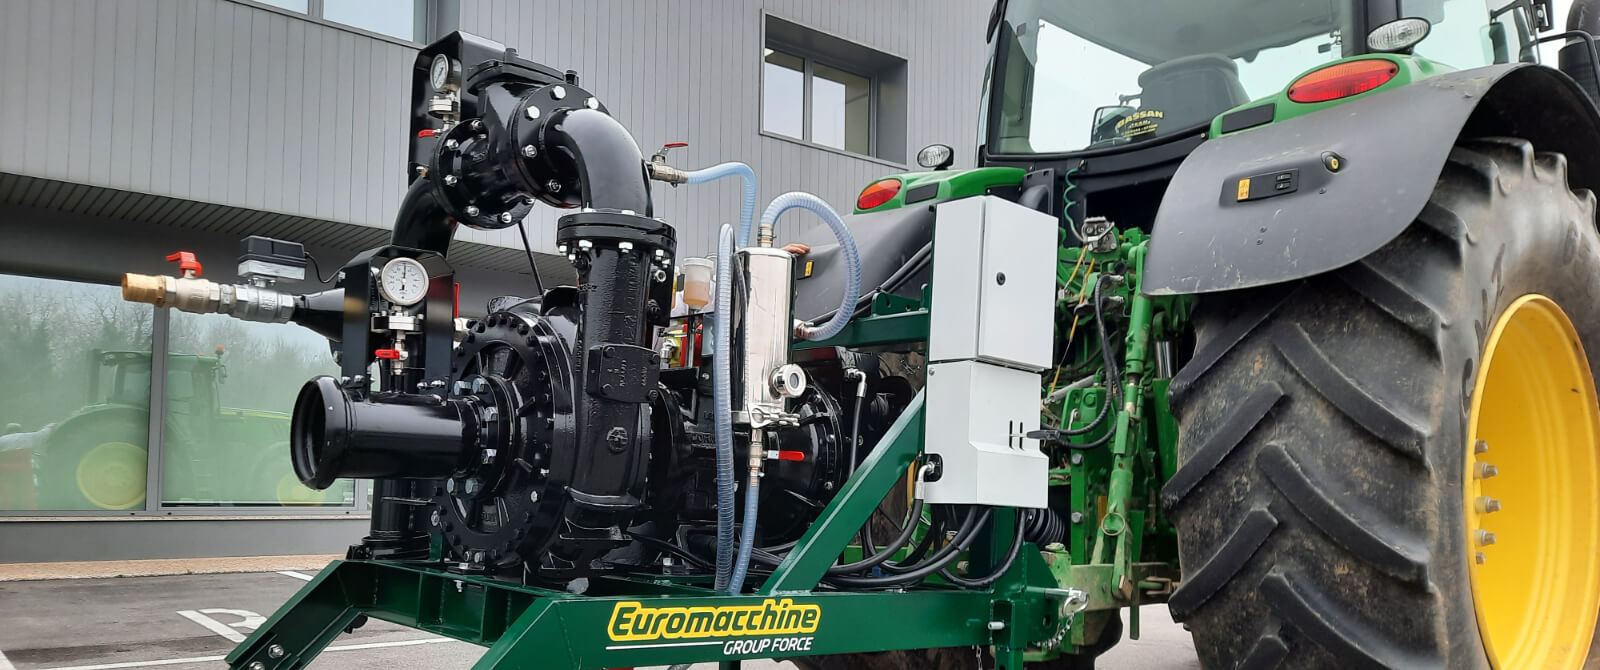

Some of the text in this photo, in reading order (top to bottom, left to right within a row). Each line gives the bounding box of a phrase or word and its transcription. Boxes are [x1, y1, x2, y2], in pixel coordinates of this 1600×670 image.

[610, 600, 820, 638] Euromacchine
[723, 637, 814, 655] GROUP FORCE
